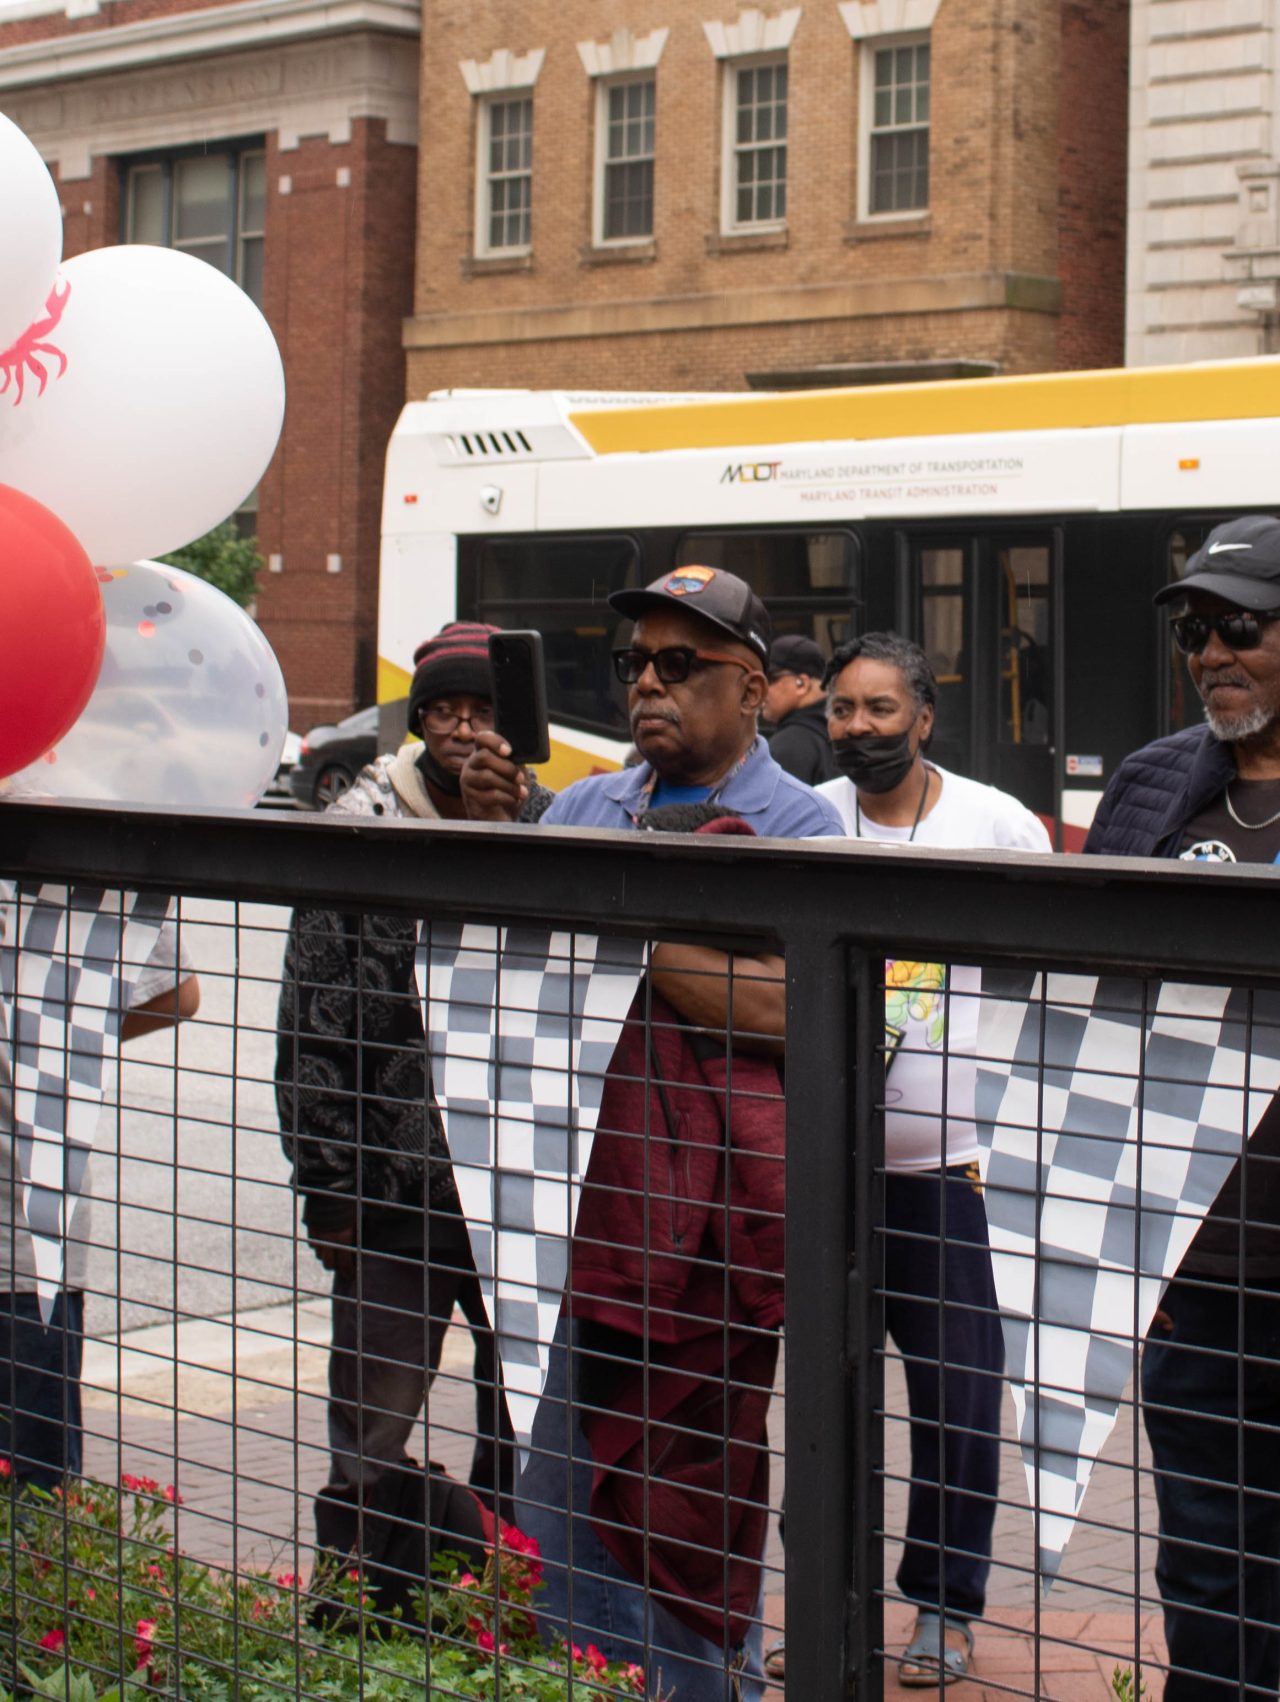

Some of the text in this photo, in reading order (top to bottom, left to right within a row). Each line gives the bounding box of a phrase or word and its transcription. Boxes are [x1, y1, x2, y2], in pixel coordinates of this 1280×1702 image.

[781, 456, 1024, 480] MARYLAND DEPARTMENT OF TRANSPORTATION
[800, 483, 998, 502] MARYLAND TRANSIT ADMINISTRATION
